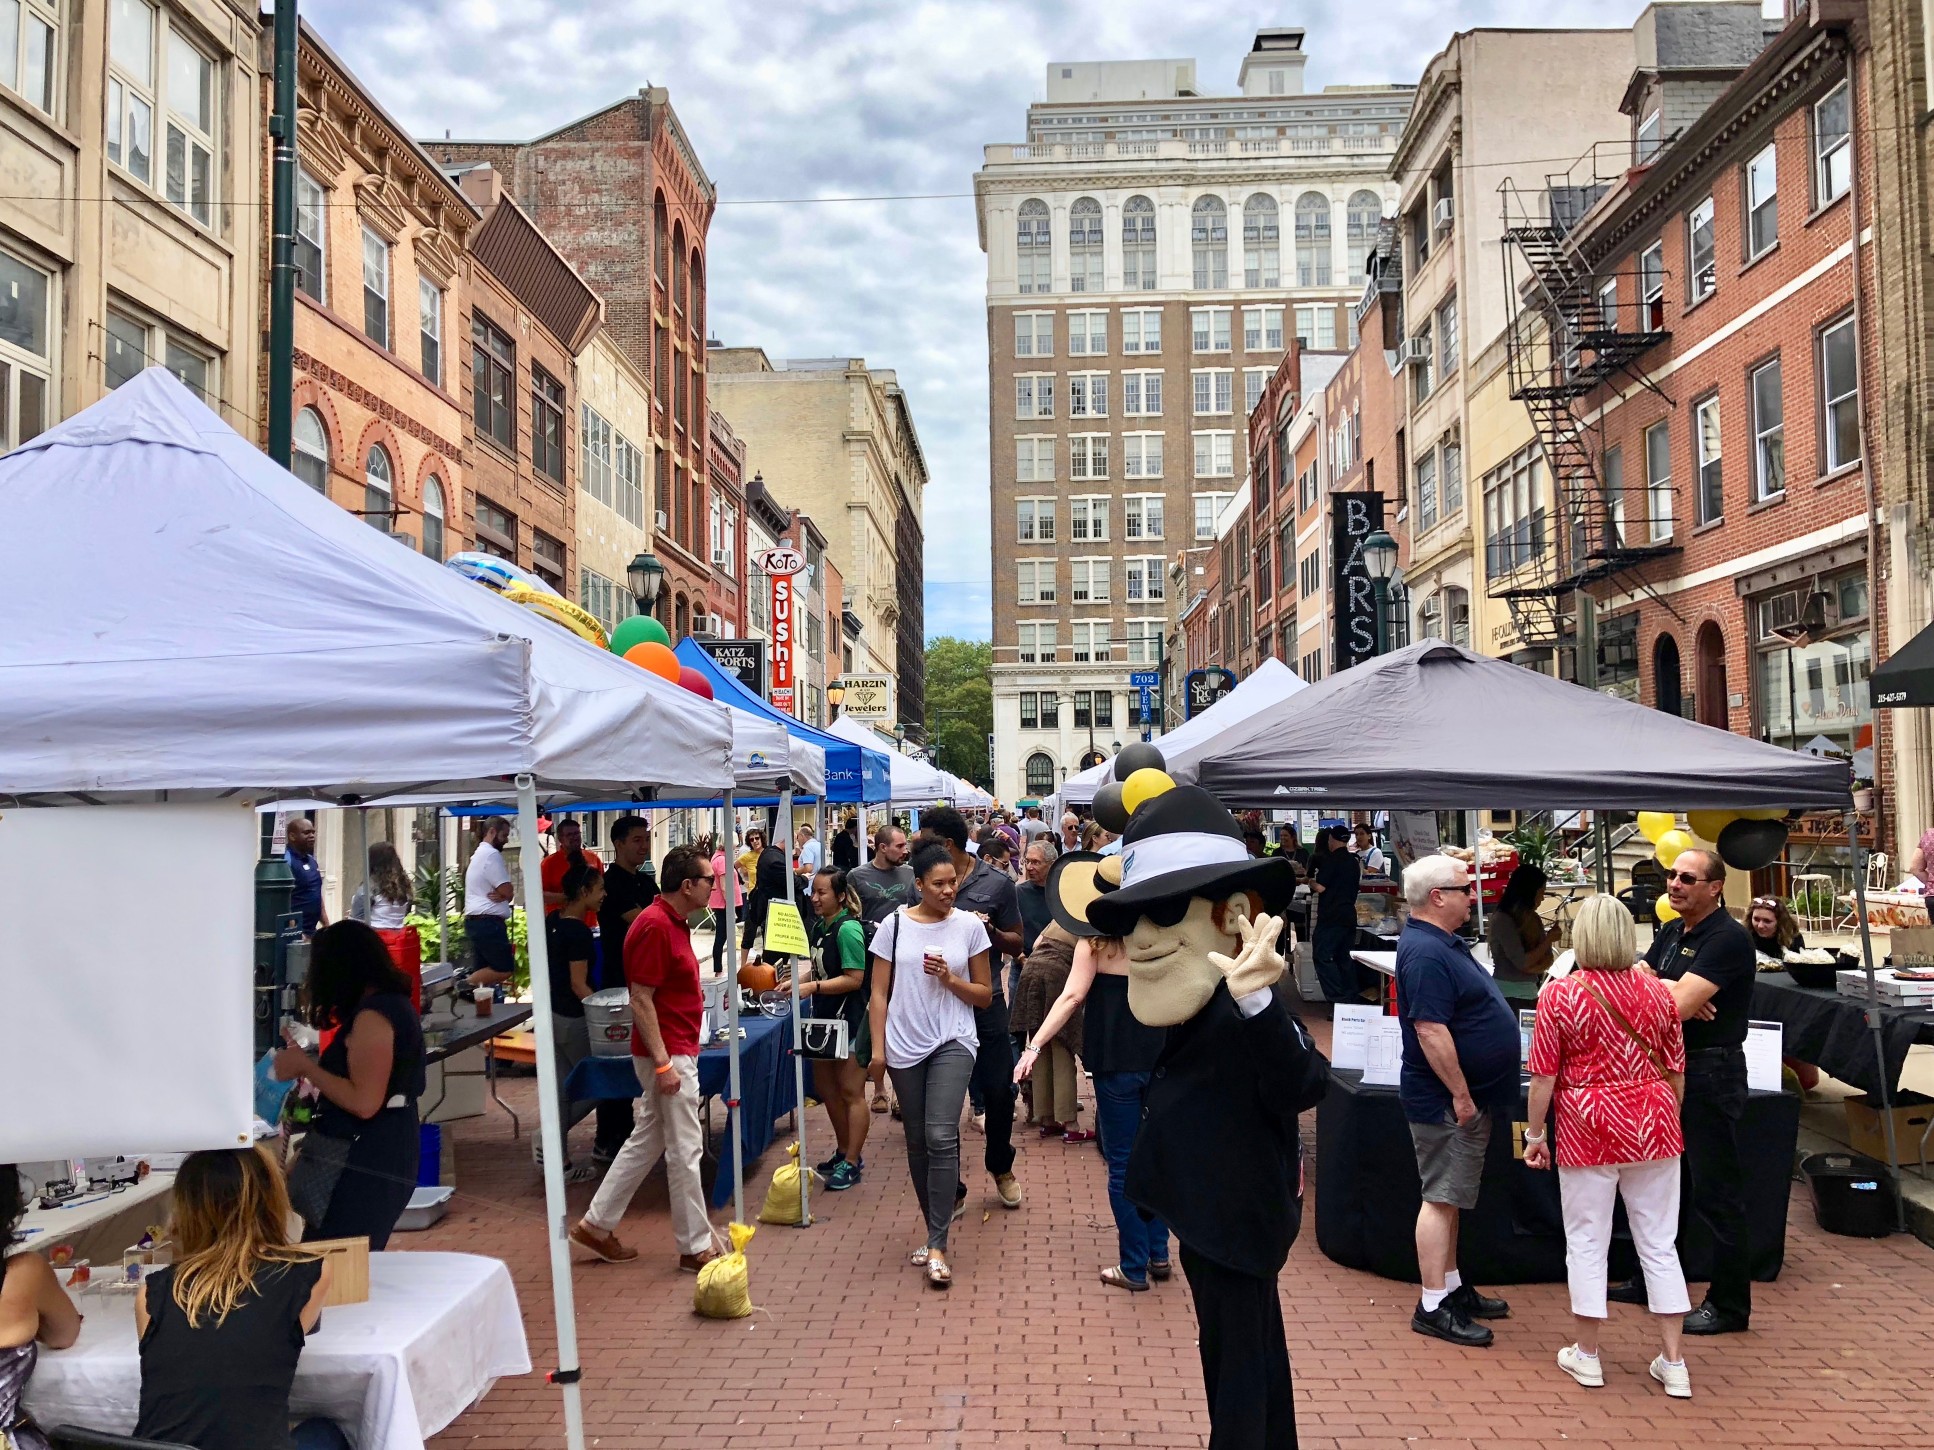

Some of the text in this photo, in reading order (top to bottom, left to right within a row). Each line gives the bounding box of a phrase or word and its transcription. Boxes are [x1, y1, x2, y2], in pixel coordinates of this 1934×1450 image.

[715, 648, 745, 657] KATZ
[714, 657, 755, 668] PORTS
[1135, 675, 1154, 683] 702
[844, 680, 887, 688] HARZIN
[824, 769, 853, 780] Bank
